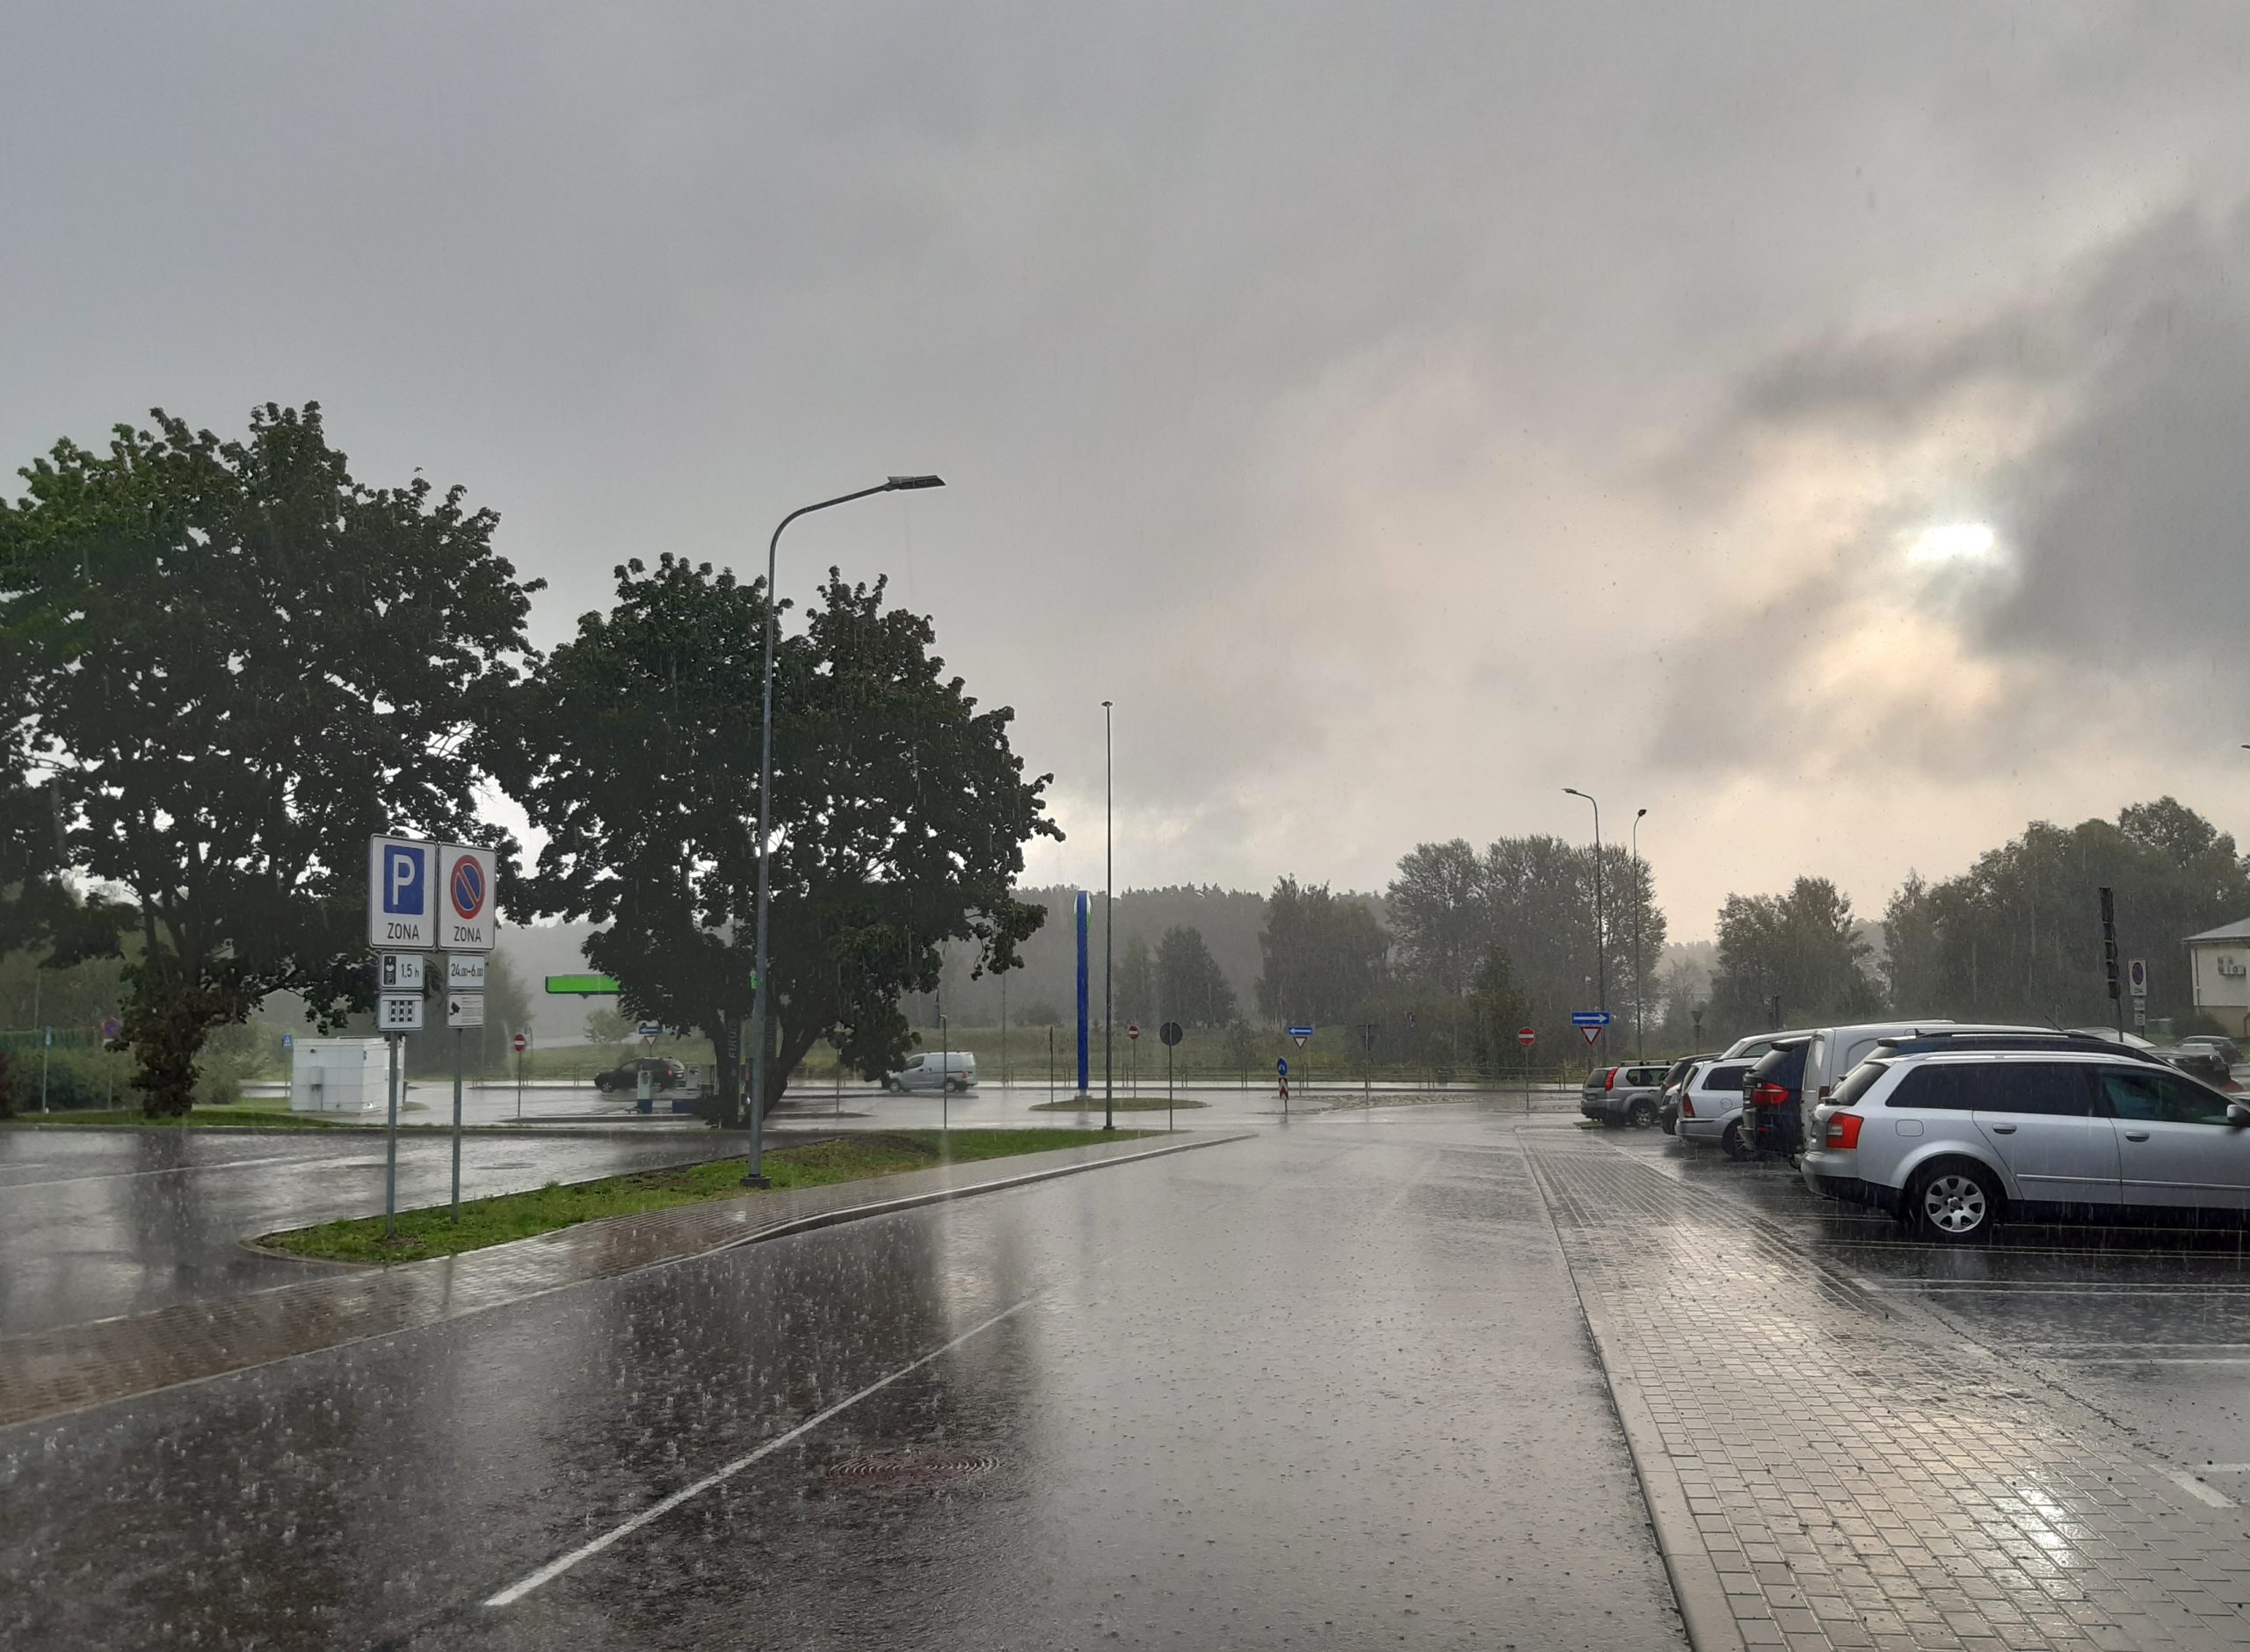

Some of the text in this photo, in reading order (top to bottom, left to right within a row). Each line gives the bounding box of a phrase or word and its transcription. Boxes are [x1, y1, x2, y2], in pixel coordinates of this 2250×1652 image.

[392, 853, 416, 906] P
[387, 923, 420, 940] ZONA
[454, 926, 482, 943] ZONA
[414, 967, 420, 978] h
